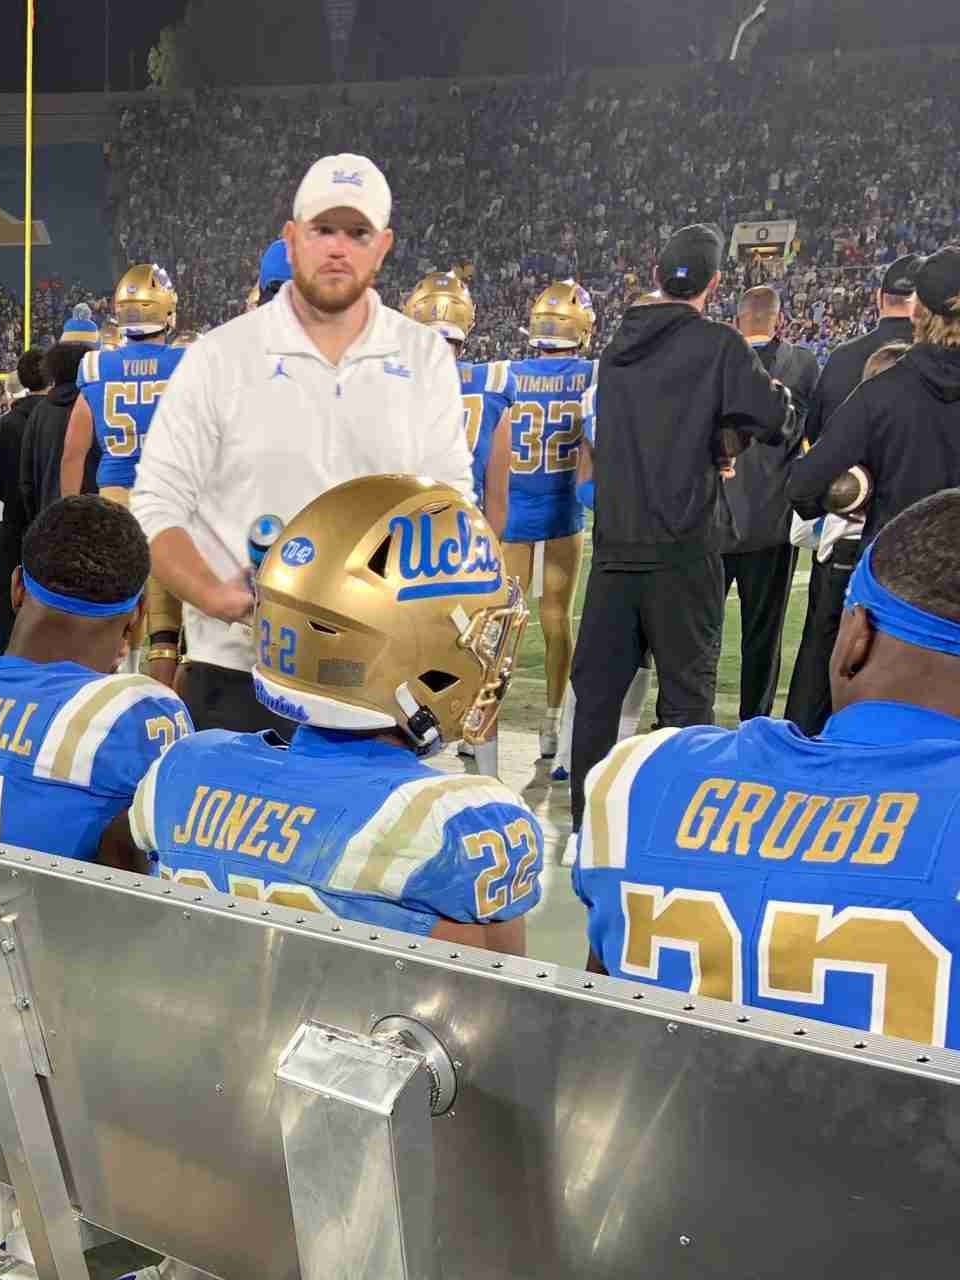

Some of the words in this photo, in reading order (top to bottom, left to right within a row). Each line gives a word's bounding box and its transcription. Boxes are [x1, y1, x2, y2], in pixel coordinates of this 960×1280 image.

[103, 380, 171, 456] 5
[511, 400, 584, 475] 32
[259, 618, 297, 675] 22
[175, 785, 317, 864] JONES
[675, 778, 920, 865] GRUBB
[463, 816, 540, 918] 22
